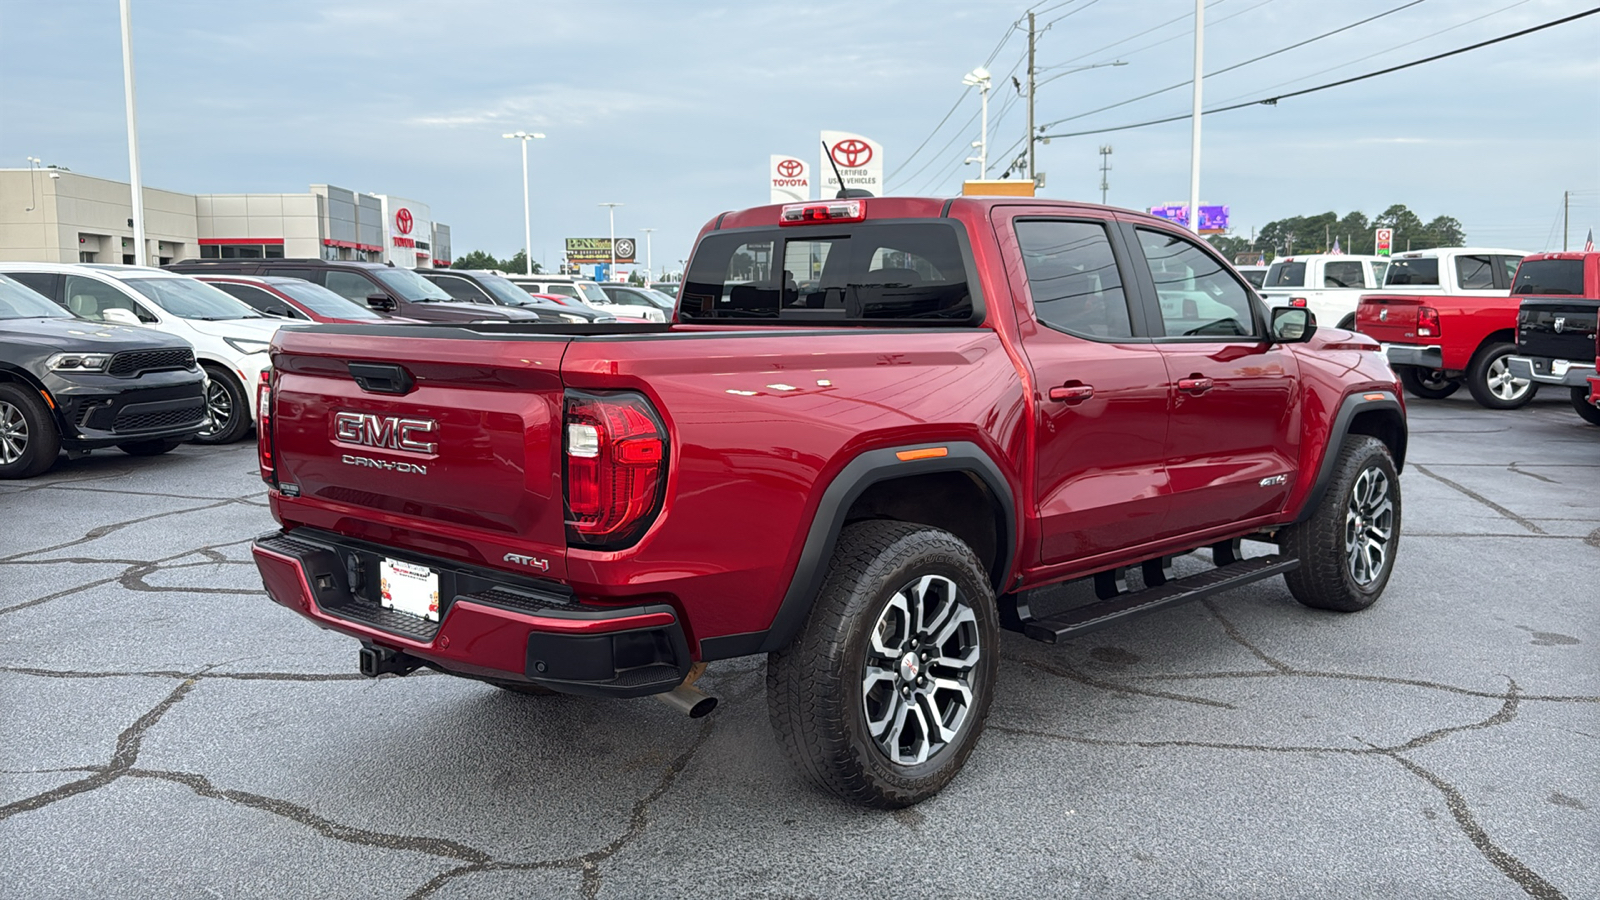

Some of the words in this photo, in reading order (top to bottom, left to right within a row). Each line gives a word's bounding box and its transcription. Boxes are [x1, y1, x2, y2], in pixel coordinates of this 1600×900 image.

[773, 179, 808, 187] TOYOTA
[828, 177, 845, 185] USD
[846, 177, 876, 185] VEHICLES
[393, 236, 415, 248] TOYOTA
[335, 412, 434, 453] GMC
[342, 454, 427, 475] CANYON
[1258, 474, 1288, 487] AT4
[503, 552, 549, 572] AT4
